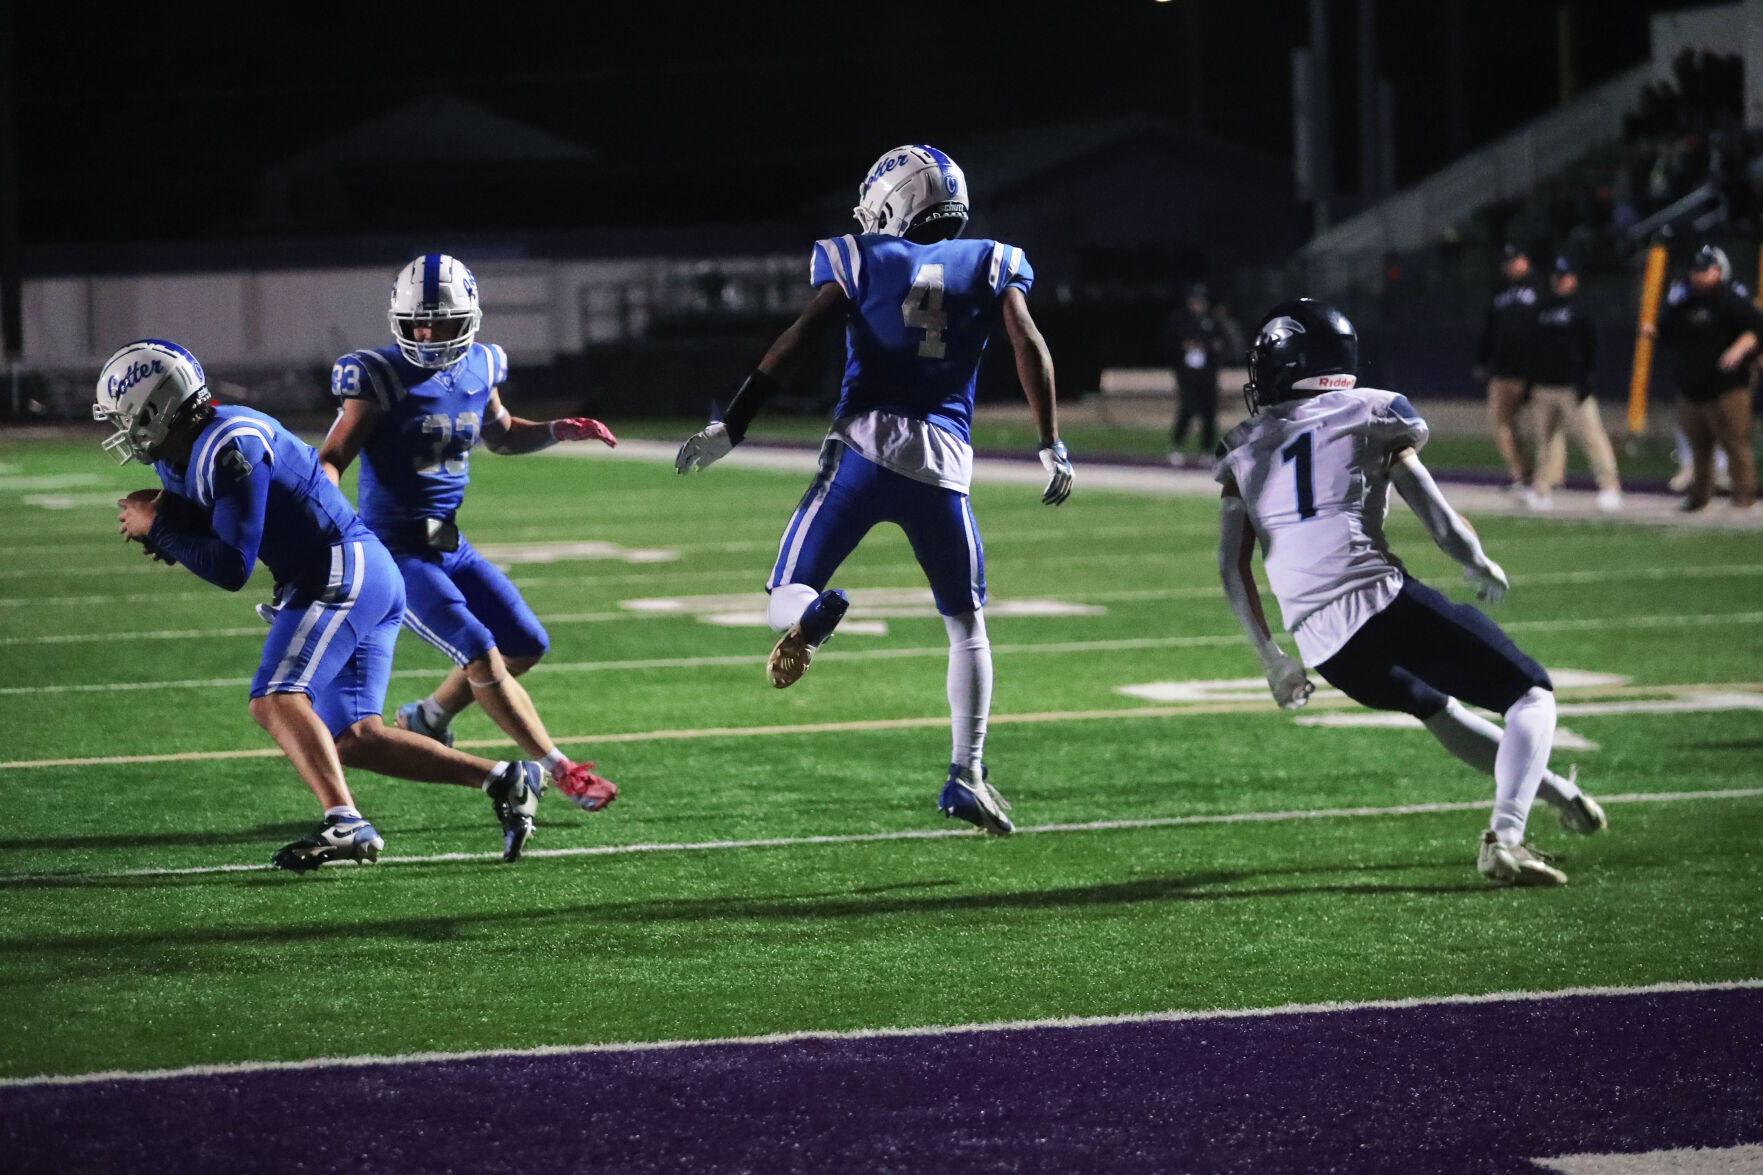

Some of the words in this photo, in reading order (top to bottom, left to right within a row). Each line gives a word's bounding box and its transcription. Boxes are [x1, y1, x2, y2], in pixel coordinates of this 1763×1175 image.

[865, 154, 909, 191] otter
[902, 263, 948, 359] 4
[107, 359, 164, 401] Cotter
[331, 363, 361, 396] 33
[413, 411, 480, 476] 33
[1281, 428, 1319, 520] 1
